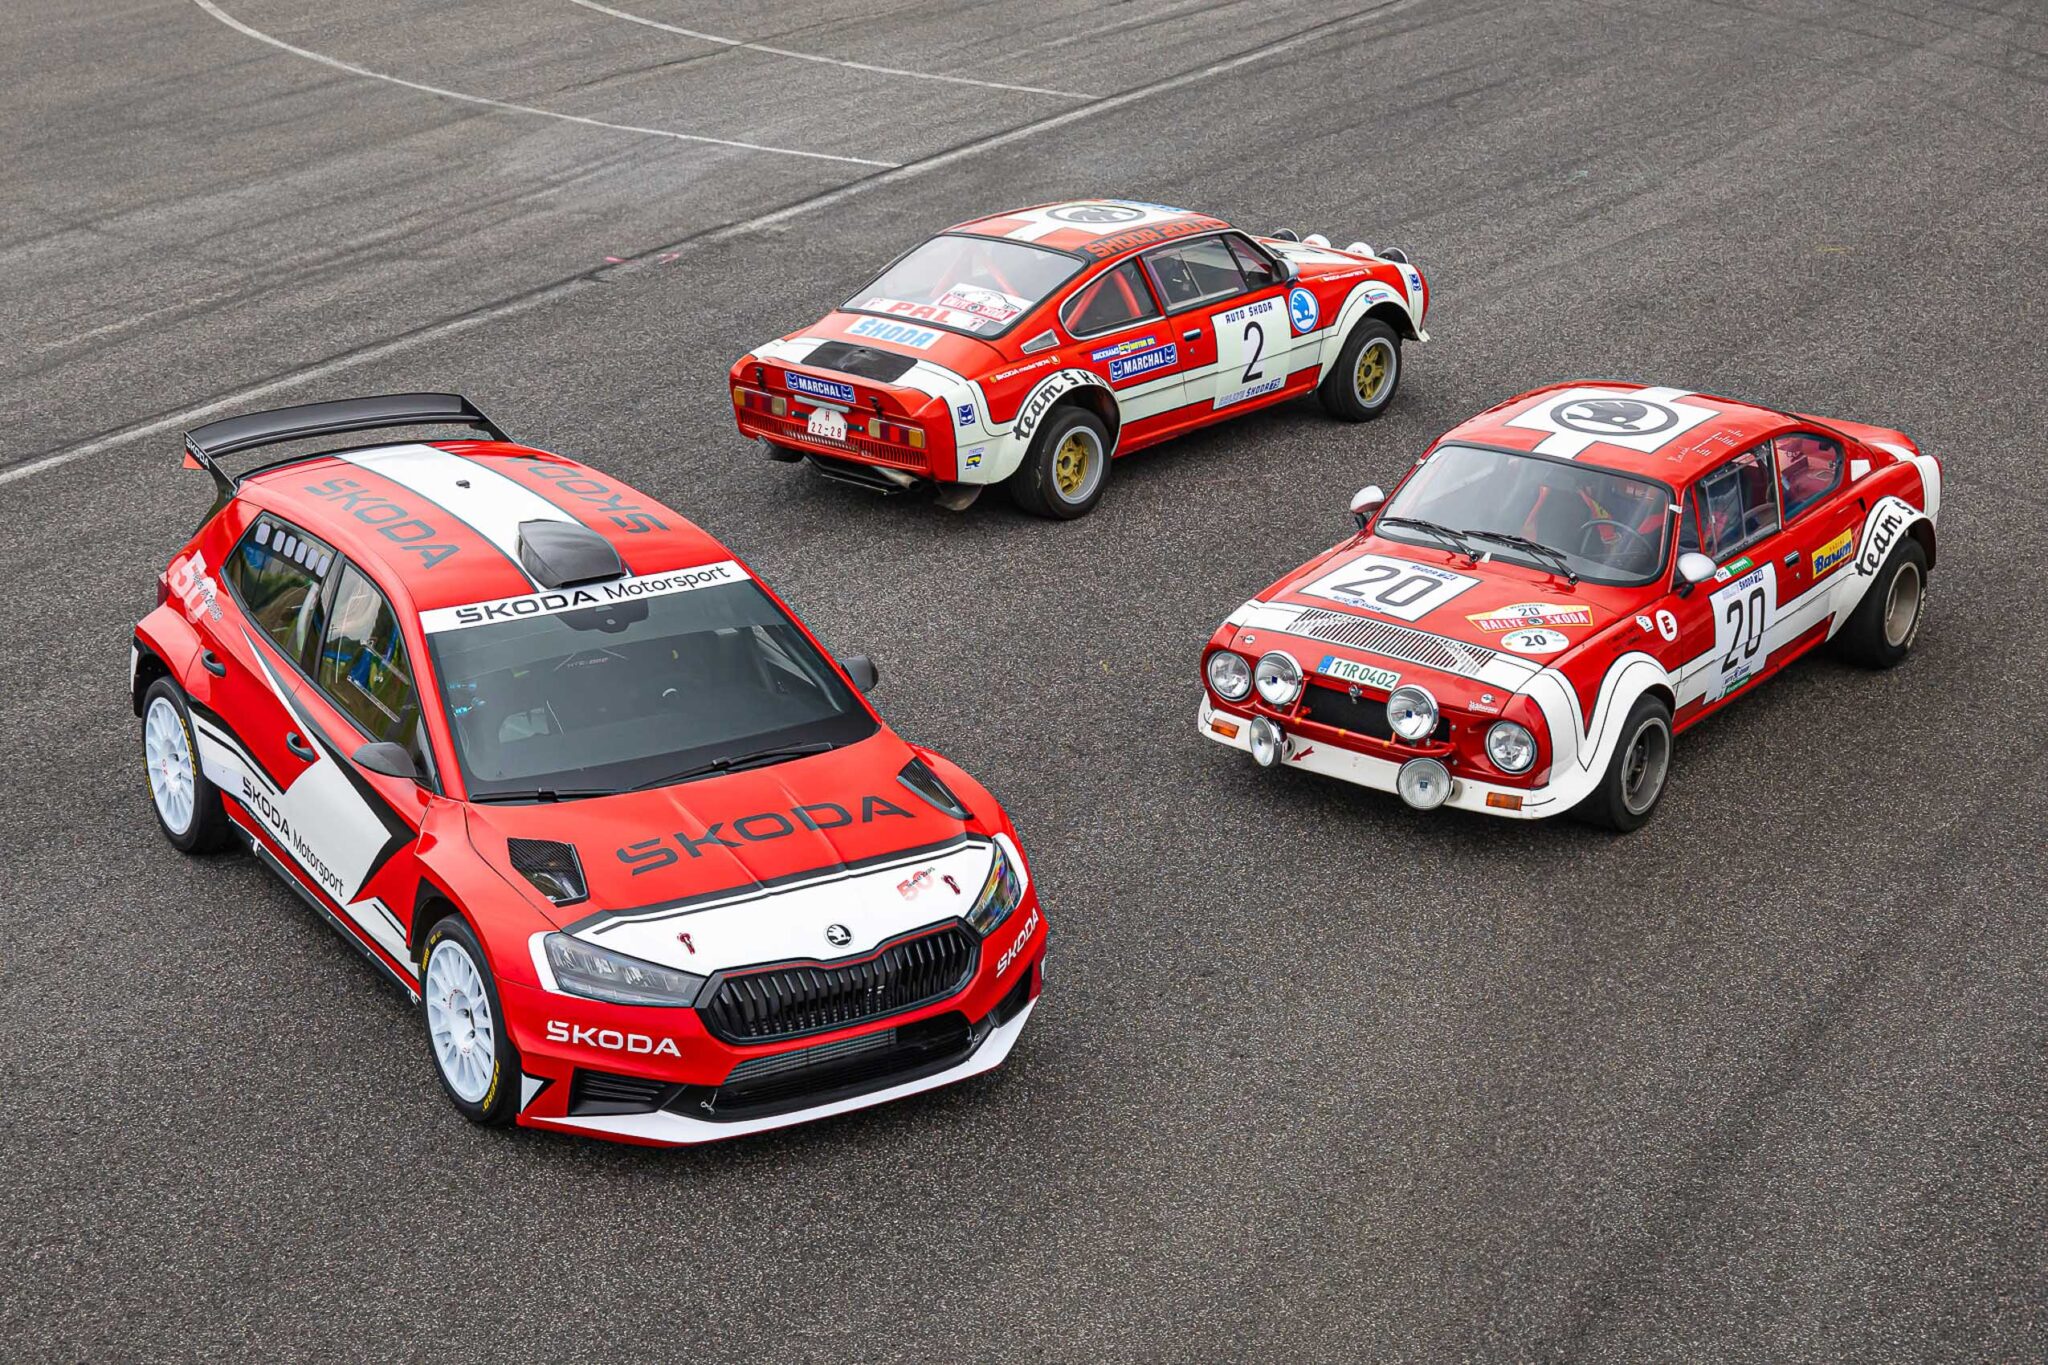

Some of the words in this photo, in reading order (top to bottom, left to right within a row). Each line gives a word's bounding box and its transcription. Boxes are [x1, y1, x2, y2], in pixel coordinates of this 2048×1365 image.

[887, 302, 949, 323] PAL
[1225, 310, 1245, 324] AUTO
[852, 319, 935, 347] ŠKODA
[1123, 351, 1165, 374] MARCHAL
[1242, 321, 1264, 384] 2
[798, 377, 841, 398] MARCHAL
[824, 411, 830, 421] H
[1012, 376, 1064, 440] team
[1855, 504, 1903, 577] team
[1814, 542, 1852, 575] Barum
[603, 565, 731, 600] Motorsport
[1330, 565, 1443, 607] 20
[1478, 618, 1526, 631] RALLYE
[1518, 607, 1541, 617] 20
[1661, 615, 1674, 634] E
[1521, 634, 1547, 647] 20
[1721, 587, 1766, 674] 20
[293, 828, 344, 898] Motorsport
